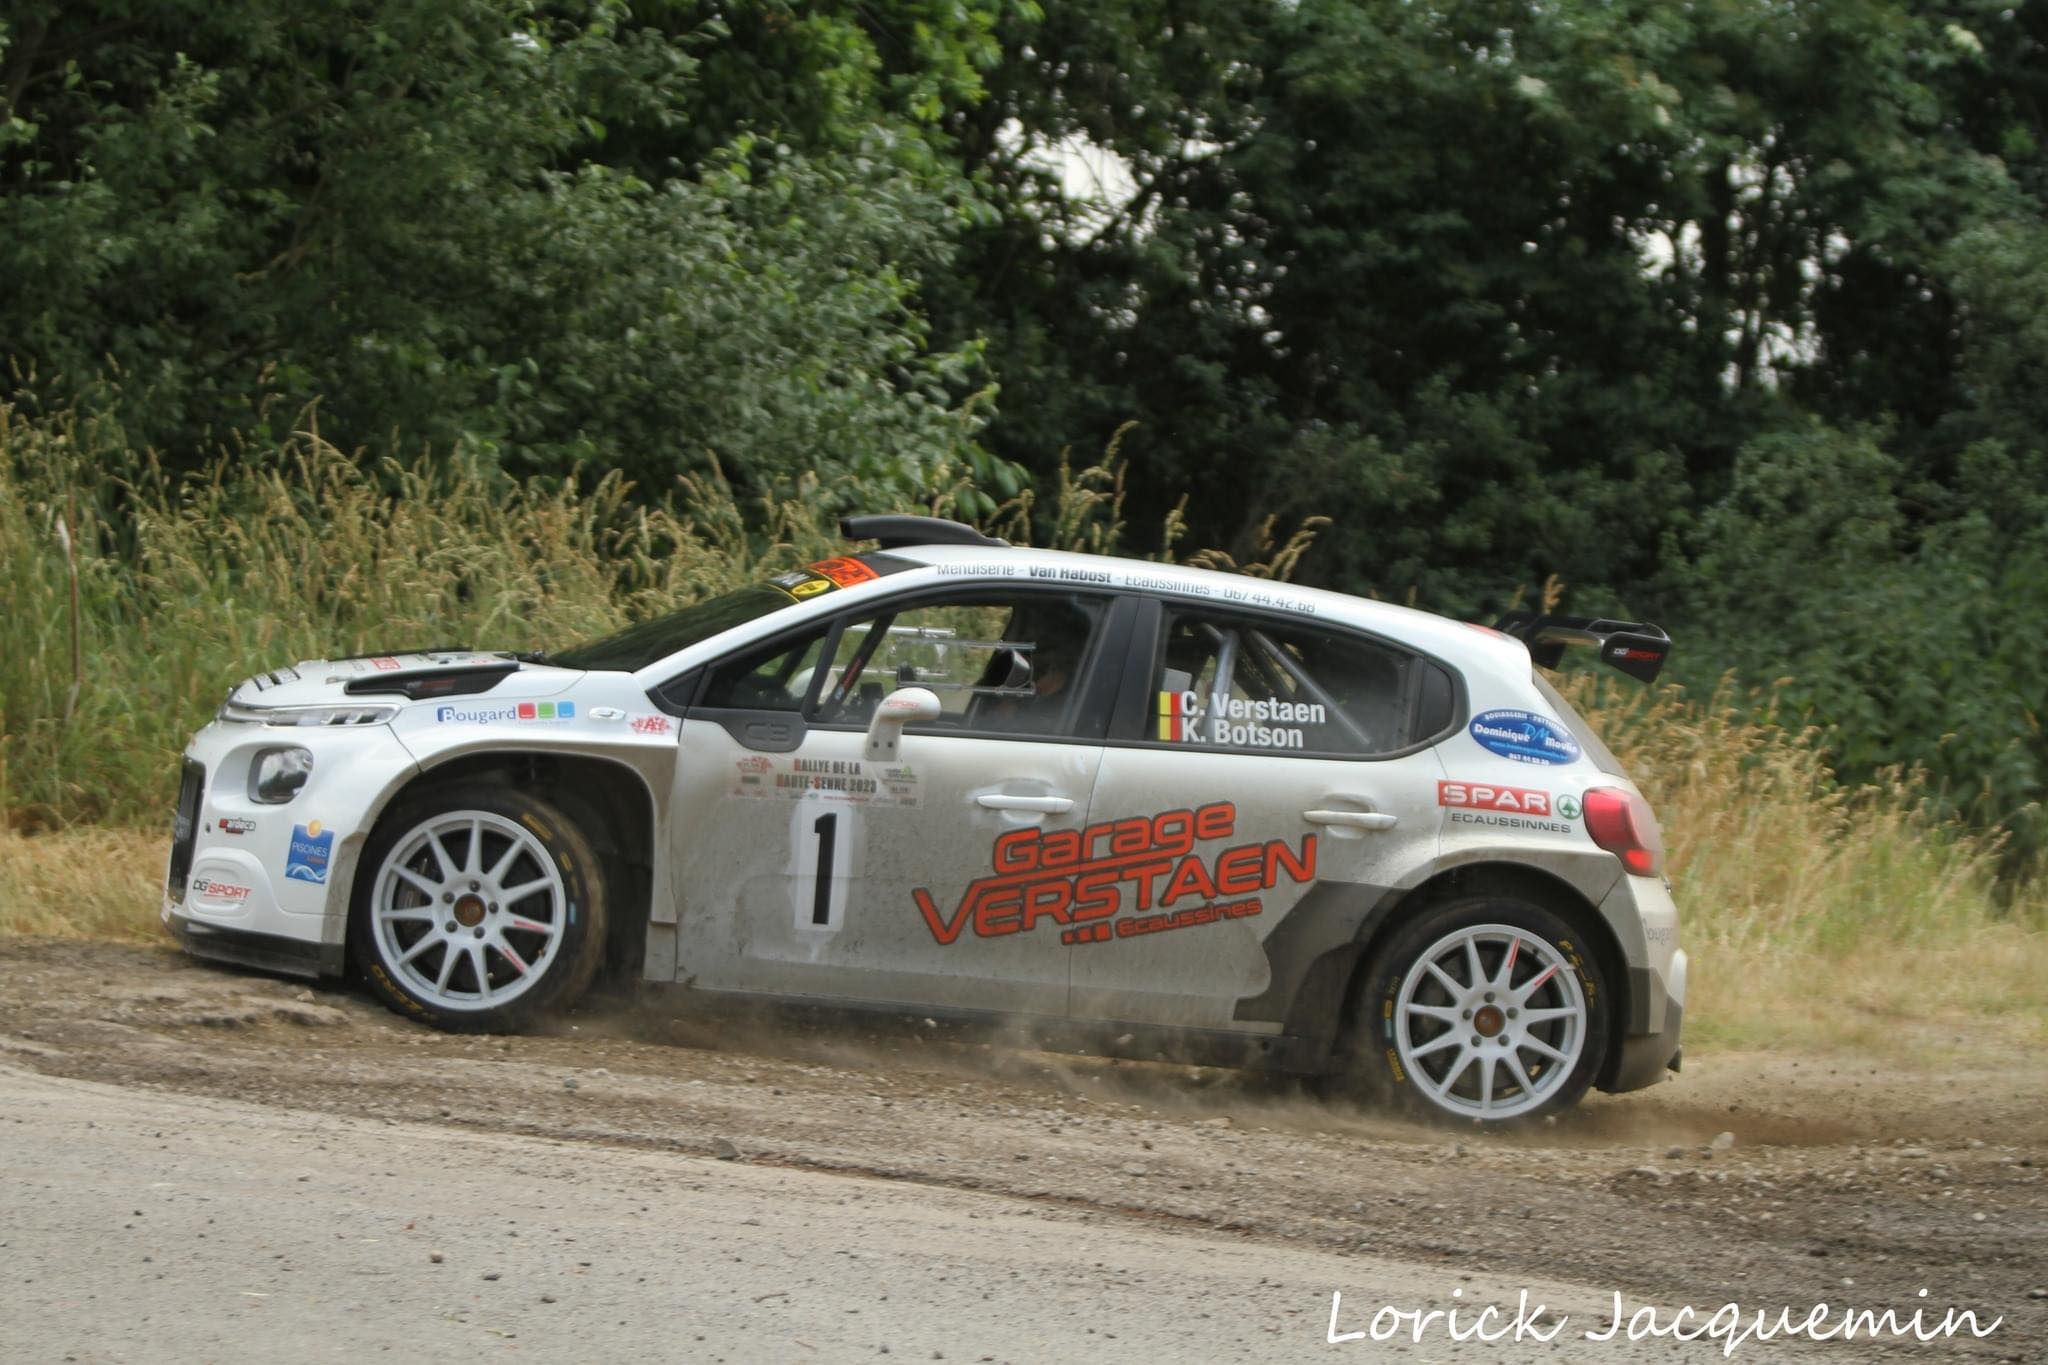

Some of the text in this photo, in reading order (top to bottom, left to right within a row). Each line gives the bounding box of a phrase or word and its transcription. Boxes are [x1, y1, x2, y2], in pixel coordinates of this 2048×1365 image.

[1029, 565, 1057, 578] Van
[437, 706, 517, 724] Bougard
[1181, 690, 1326, 724] C. Verstaen
[1182, 717, 1304, 748] K. Botson
[1474, 723, 1531, 742] Dominique
[794, 758, 861, 775] RALLYE DE LA
[849, 778, 877, 793] 2023
[1444, 784, 1547, 811] SPAR
[1452, 812, 1572, 833] ECAUSSINNES
[993, 801, 1236, 874] Garage
[812, 813, 837, 925] 1
[912, 833, 1318, 945] VERSTAEN
